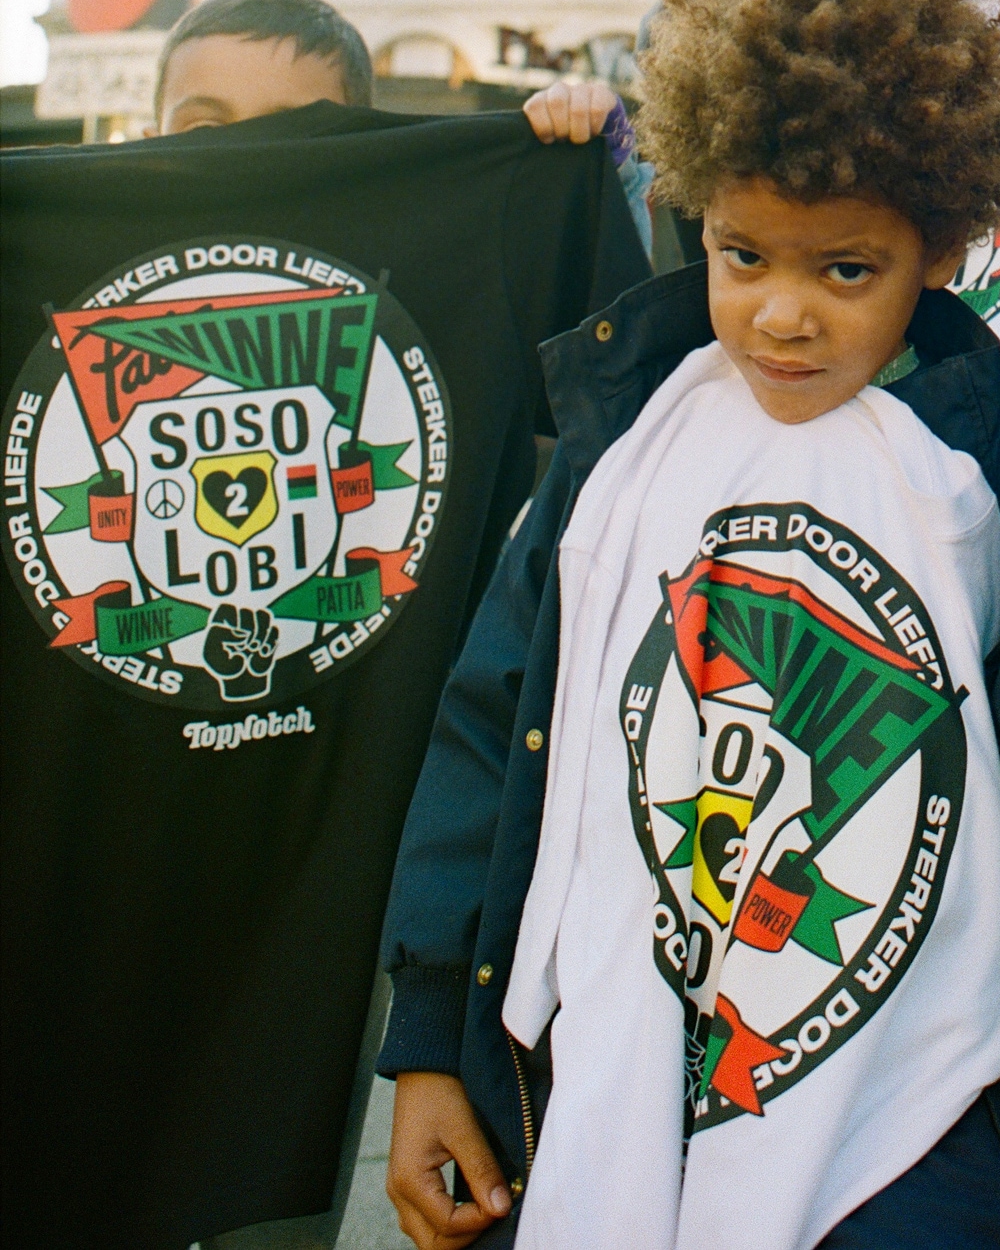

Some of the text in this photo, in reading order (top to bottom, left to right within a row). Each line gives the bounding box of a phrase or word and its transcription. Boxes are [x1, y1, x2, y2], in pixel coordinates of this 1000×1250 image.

[185, 244, 277, 270] DOOR
[125, 303, 368, 417] WINNE
[149, 398, 309, 470] SOSO
[403, 346, 447, 483] STERKER
[4, 391, 42, 511] LIEFDE
[224, 482, 249, 517] 2
[337, 478, 370, 499] POWER
[98, 508, 127, 529] UNITY
[165, 512, 307, 596] LOBI
[787, 514, 880, 593] DOOR
[116, 606, 173, 646] WINNE
[316, 581, 365, 616] PATTA
[745, 894, 792, 938] POWER
[854, 793, 951, 993] STERKER
